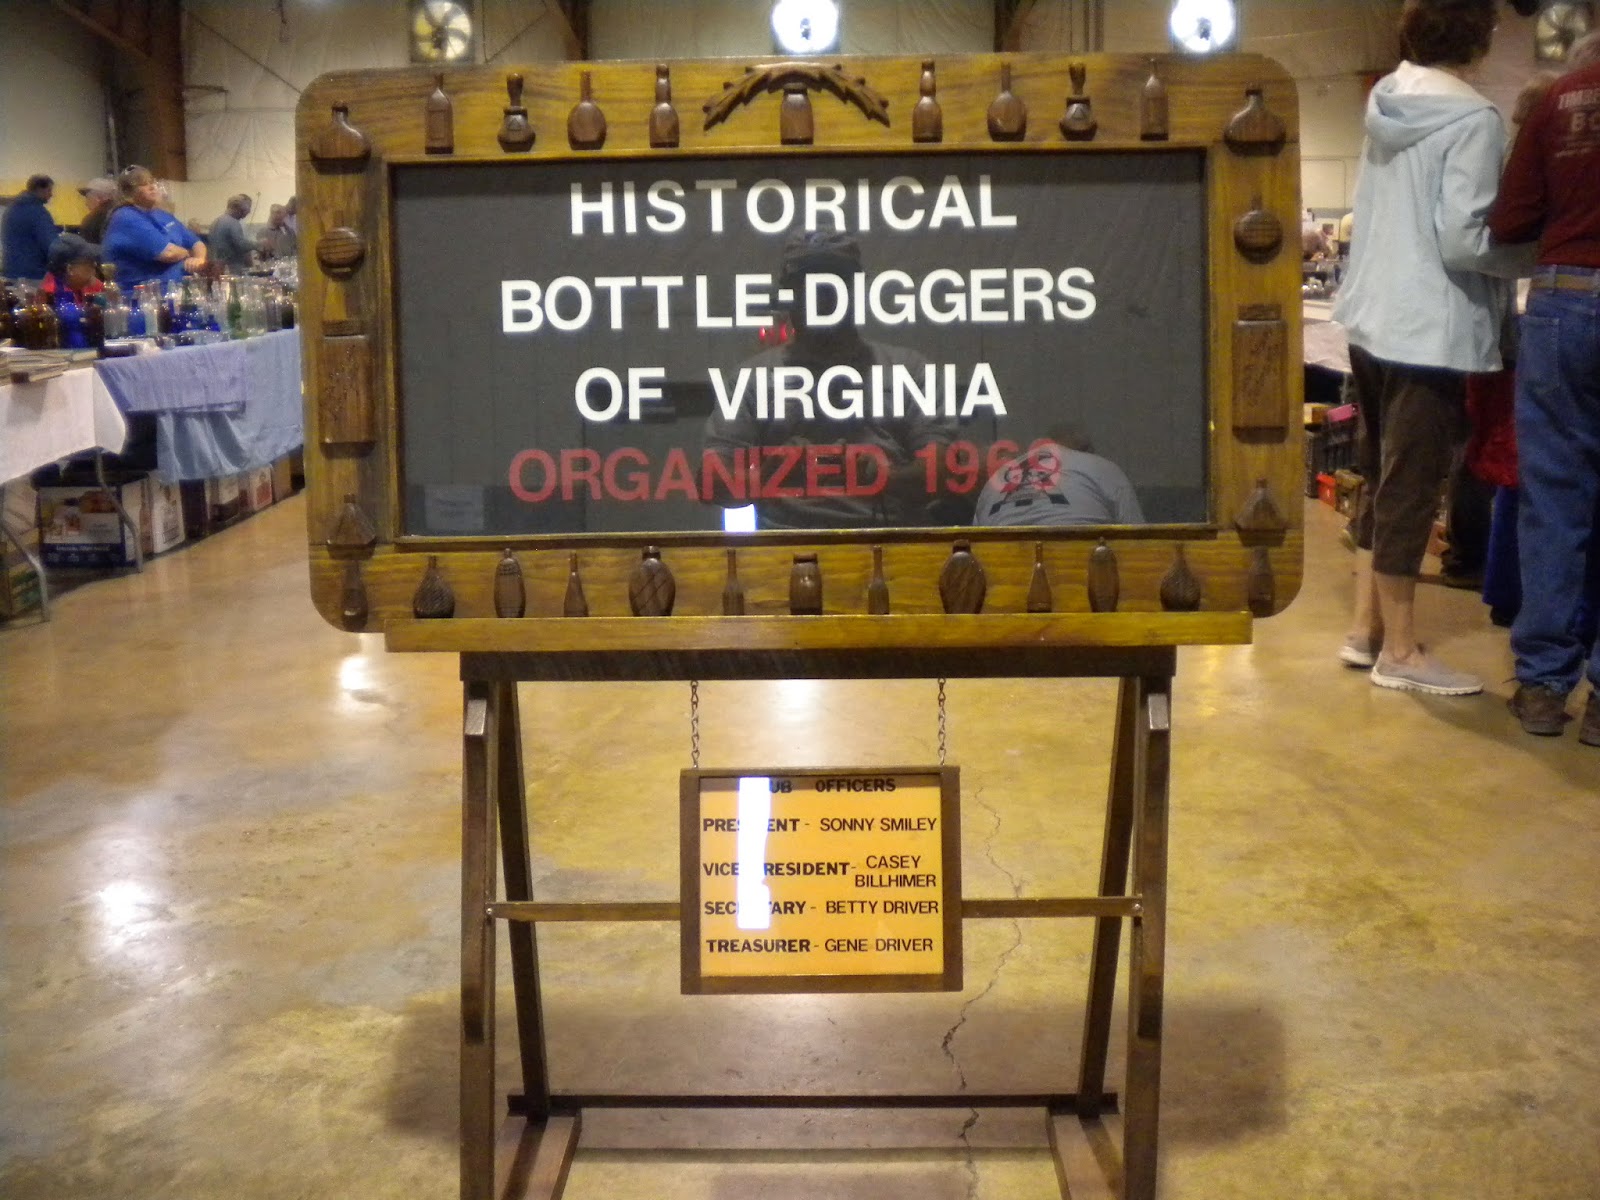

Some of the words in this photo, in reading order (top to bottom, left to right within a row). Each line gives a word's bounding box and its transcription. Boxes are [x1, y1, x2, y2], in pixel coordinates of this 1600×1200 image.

[569, 175, 1017, 235] HISTORICAL
[502, 267, 1096, 334] BOTTLE-DIGGERS
[574, 367, 666, 421] OF
[708, 363, 1005, 420] VIRGINIA
[509, 444, 889, 502] ORGANIZED
[816, 779, 896, 792] OFFICERS
[703, 819, 800, 831] PREENT
[820, 818, 874, 831] SONNY
[880, 818, 936, 831] SMILEY
[866, 856, 921, 868] CASEY
[703, 863, 739, 876] VICE
[855, 875, 936, 888] BILLHIMER
[704, 901, 806, 914] SECARY
[826, 901, 878, 914] BETTY
[884, 901, 938, 914] DRIVER
[706, 940, 810, 952] TREASURER
[824, 939, 868, 952] GENE
[876, 939, 933, 952] DRIVER
